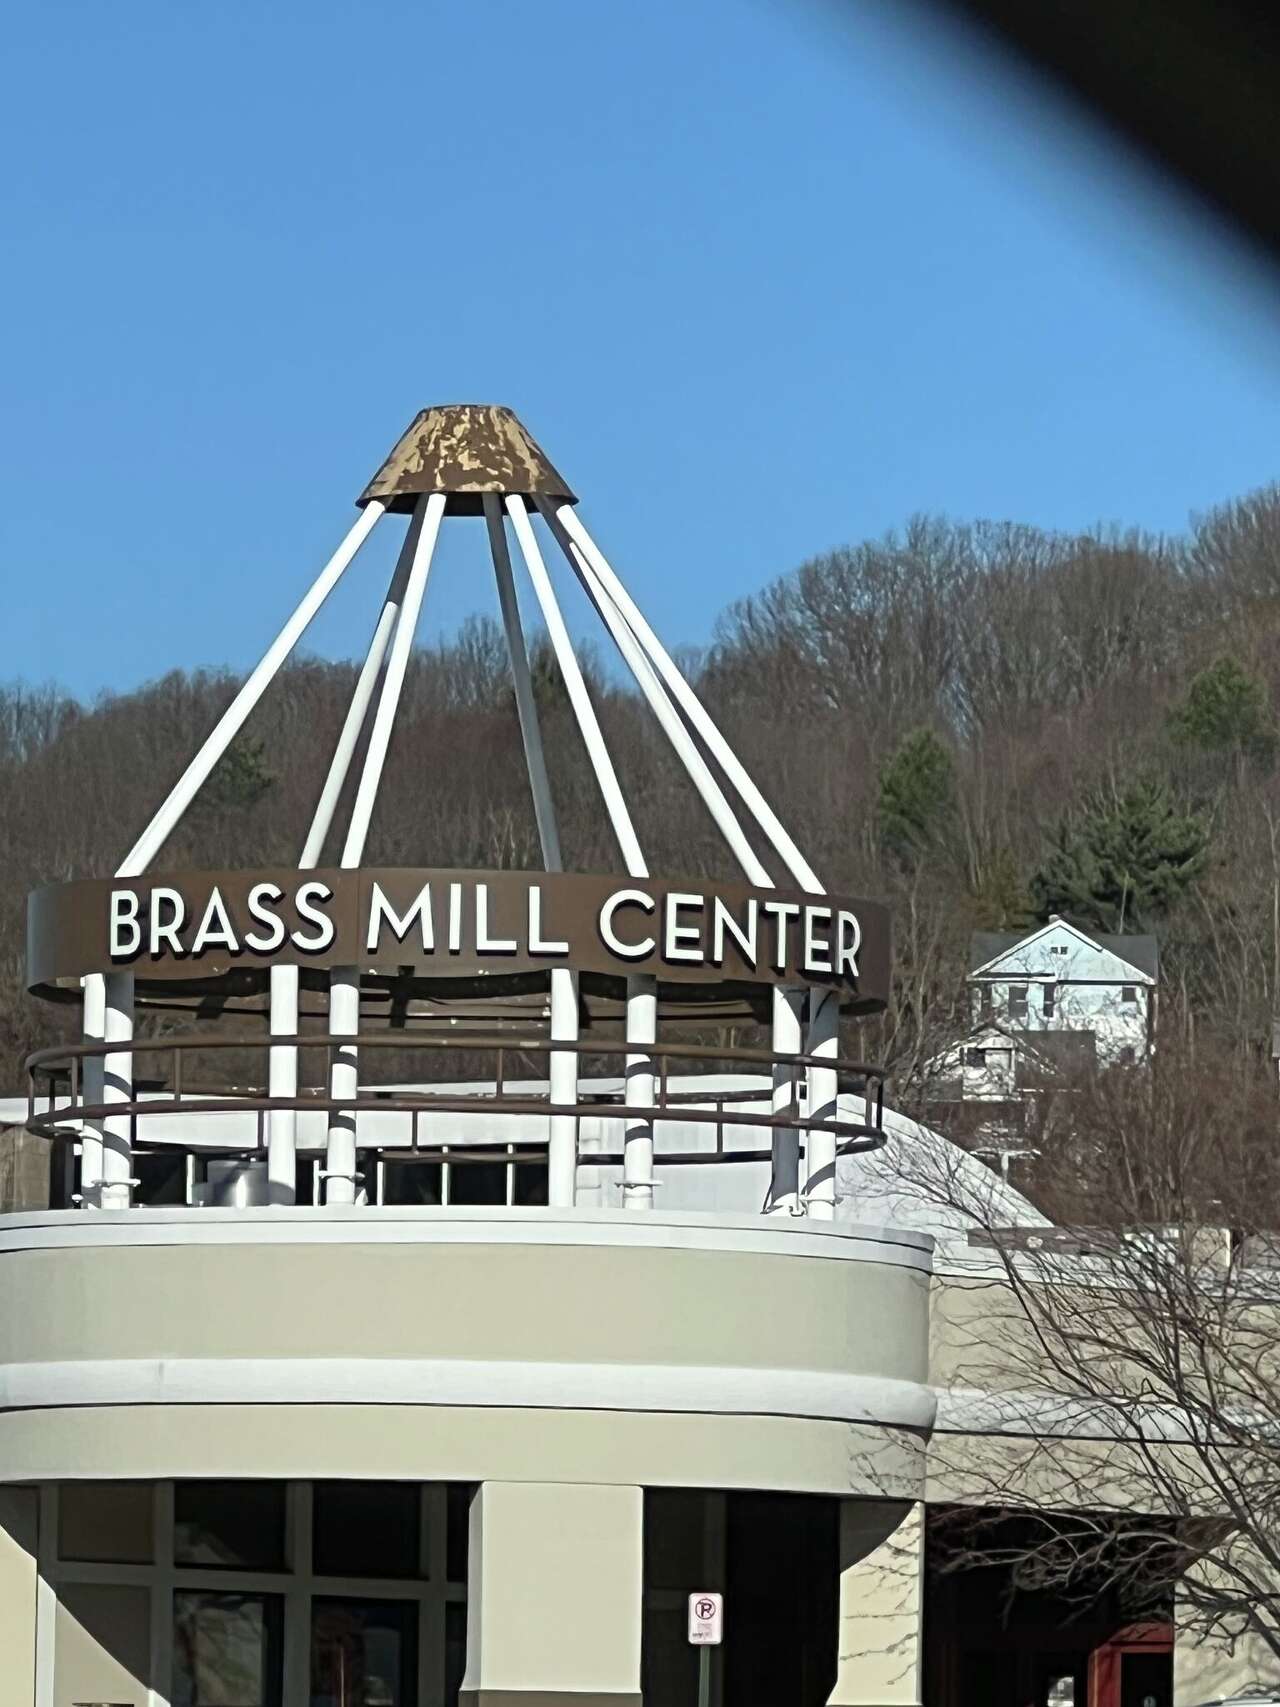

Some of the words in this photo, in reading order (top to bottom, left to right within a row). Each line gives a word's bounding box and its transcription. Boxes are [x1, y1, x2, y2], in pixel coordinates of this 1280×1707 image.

[109, 881, 335, 957] BRASS
[366, 881, 570, 954] MILL
[599, 889, 862, 978] CENTER
